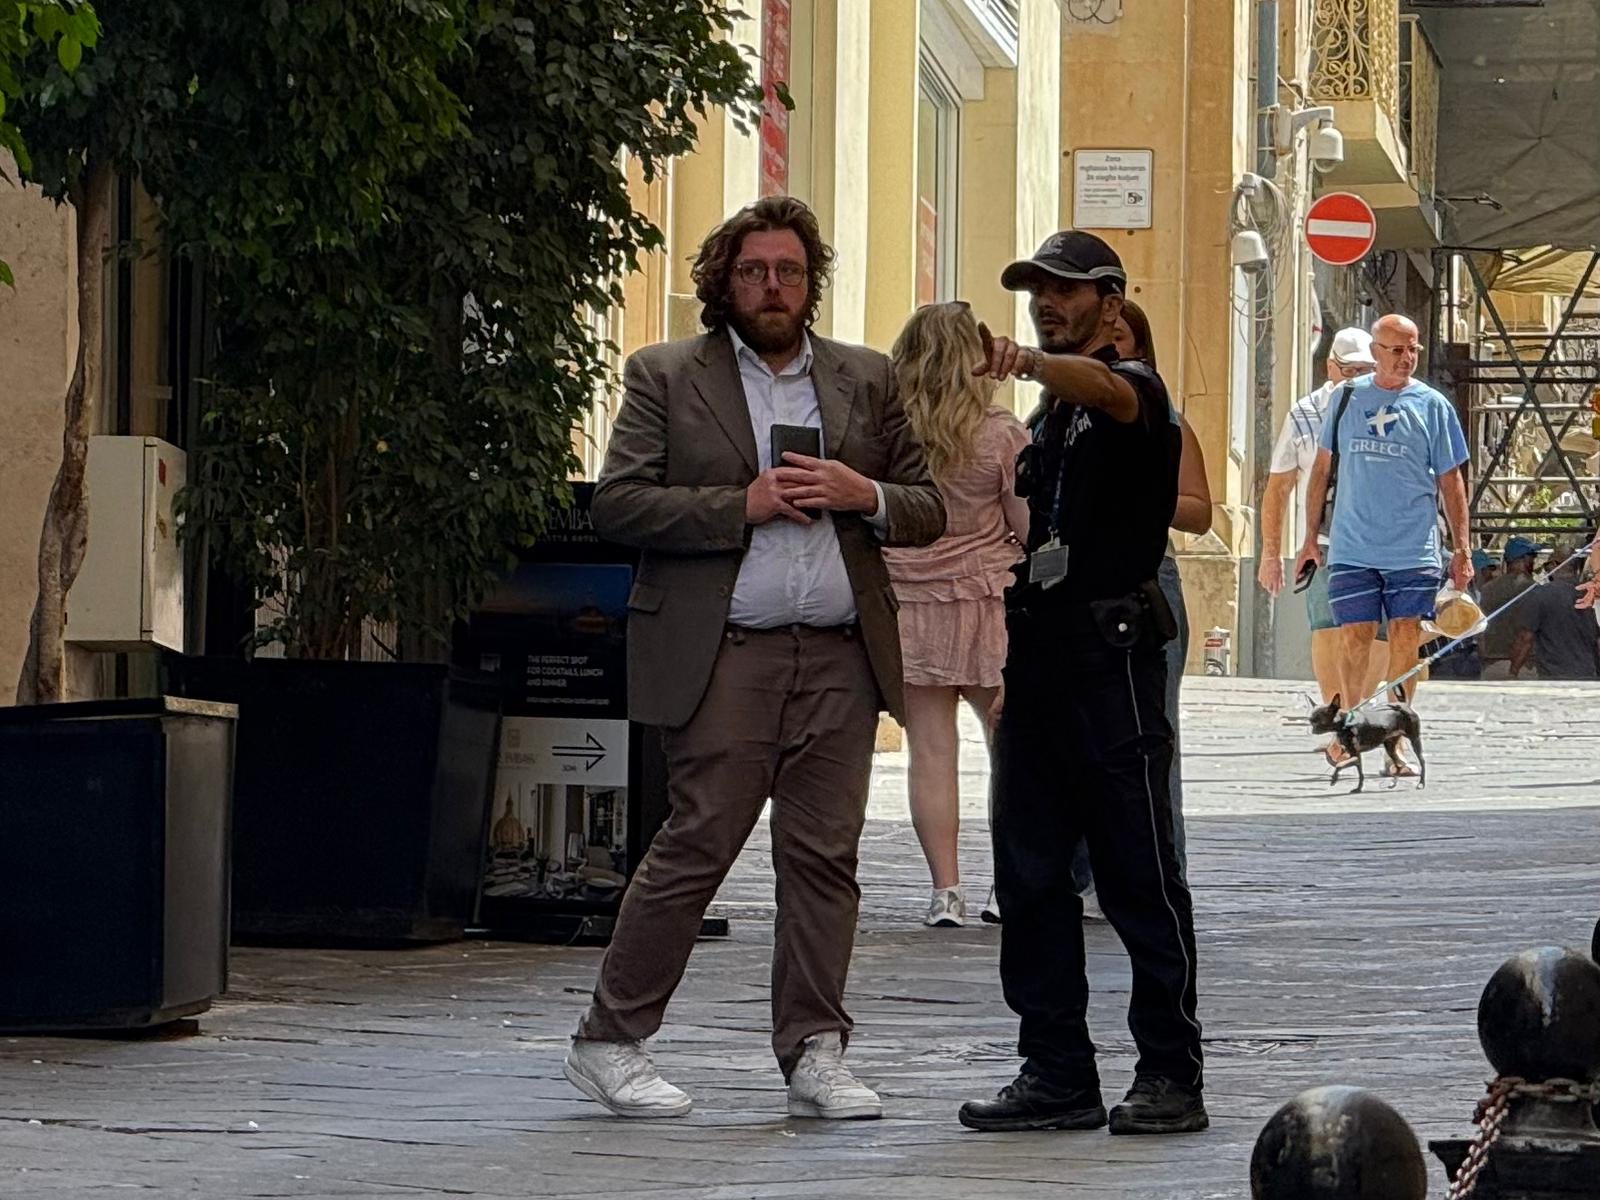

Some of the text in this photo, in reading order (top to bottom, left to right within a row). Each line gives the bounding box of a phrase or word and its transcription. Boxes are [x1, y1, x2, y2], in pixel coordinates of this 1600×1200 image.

[1348, 438, 1408, 458] GREECE
[541, 655, 569, 664] PERFECT
[571, 656, 589, 664] SPOT
[527, 666, 540, 674] FOR
